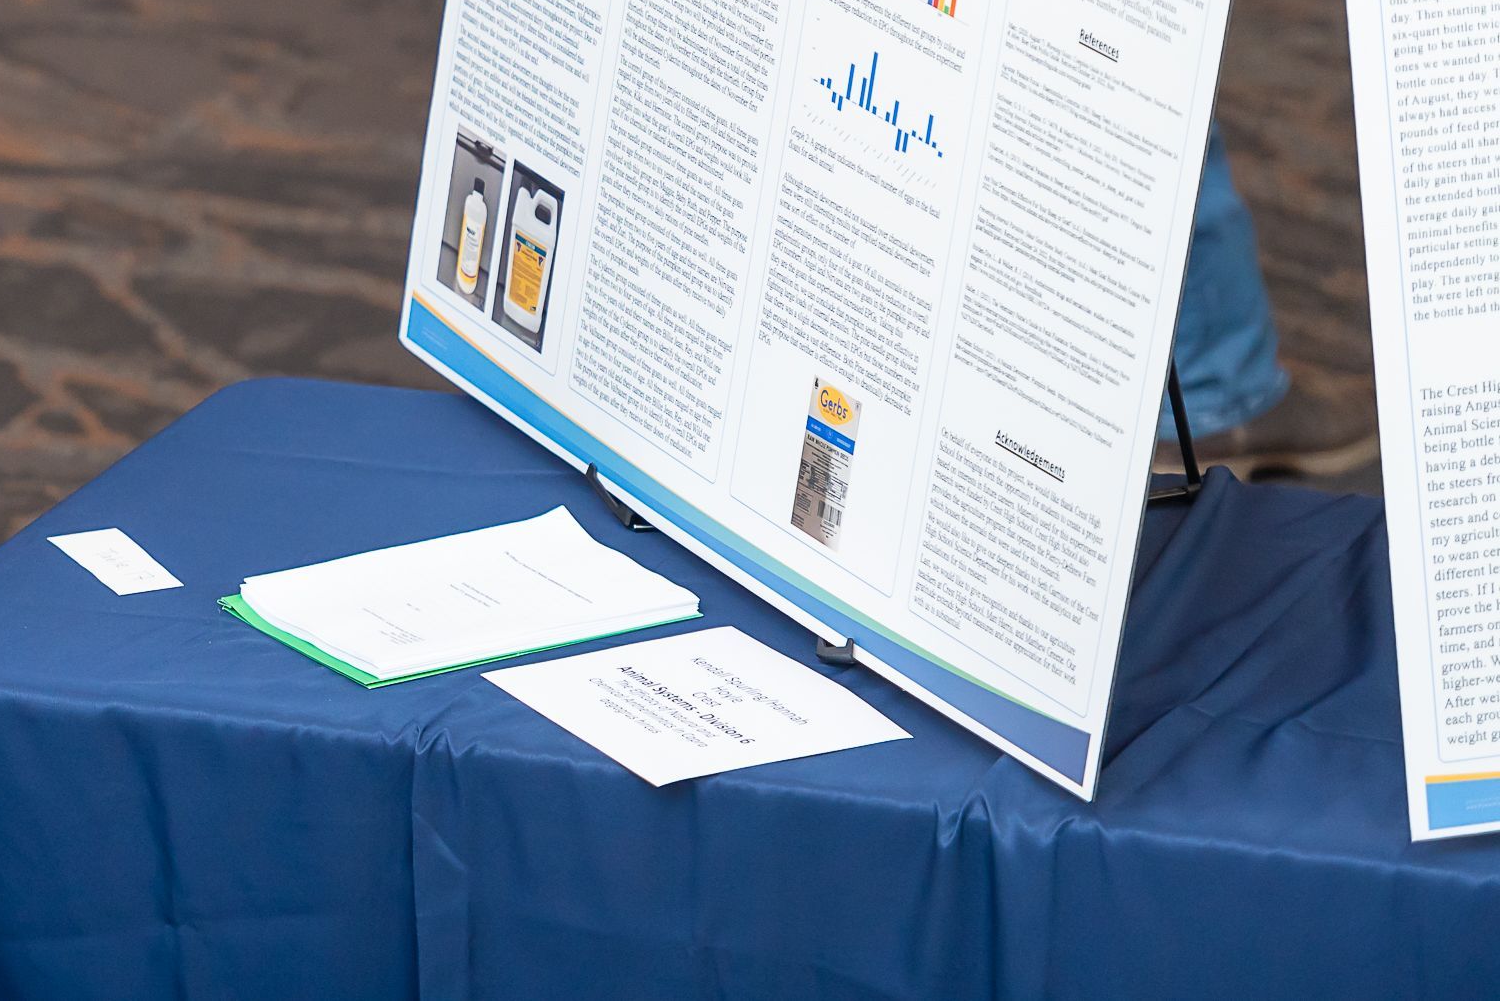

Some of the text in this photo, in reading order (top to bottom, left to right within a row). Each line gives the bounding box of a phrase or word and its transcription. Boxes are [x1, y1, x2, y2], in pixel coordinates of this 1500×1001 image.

[1079, 28, 1119, 58] References
[1398, 103, 1496, 122] always had access
[1403, 176, 1430, 189] daily
[1433, 175, 1457, 188] gain
[1459, 170, 1483, 182] than
[1407, 219, 1498, 240] minimal benefits
[1408, 236, 1499, 258] particular setting
[1409, 253, 1499, 272] independently to
[1419, 383, 1478, 400] The Crest
[820, 389, 848, 420] Gerbs
[1421, 403, 1462, 417] raising
[1422, 419, 1467, 437] Animal
[1423, 434, 1494, 454] being bottle
[995, 429, 1065, 482] Acknowledgements
[1425, 458, 1476, 473] having a
[1426, 476, 1483, 492] the steers
[1428, 492, 1496, 509] research on
[1429, 509, 1489, 528] steers and
[1430, 535, 1450, 547] my
[1432, 550, 1479, 564] to wean
[1433, 566, 1484, 581] different
[1435, 581, 1495, 601] steers. If I
[1436, 600, 1492, 621] prove the
[1438, 623, 1483, 637] farmers
[1439, 634, 1495, 654] time, and
[1441, 656, 1486, 676] growth.
[691, 656, 809, 725] Kendall Spurling/Hannah
[692, 690, 722, 708] Crest
[712, 685, 744, 704] Hoyle
[616, 665, 657, 688] Animal
[651, 685, 699, 712] Systems
[699, 713, 744, 740] Division
[740, 737, 756, 745] 6
[1444, 694, 1475, 709] After
[1444, 711, 1472, 726] each
[1446, 729, 1487, 745] weight
